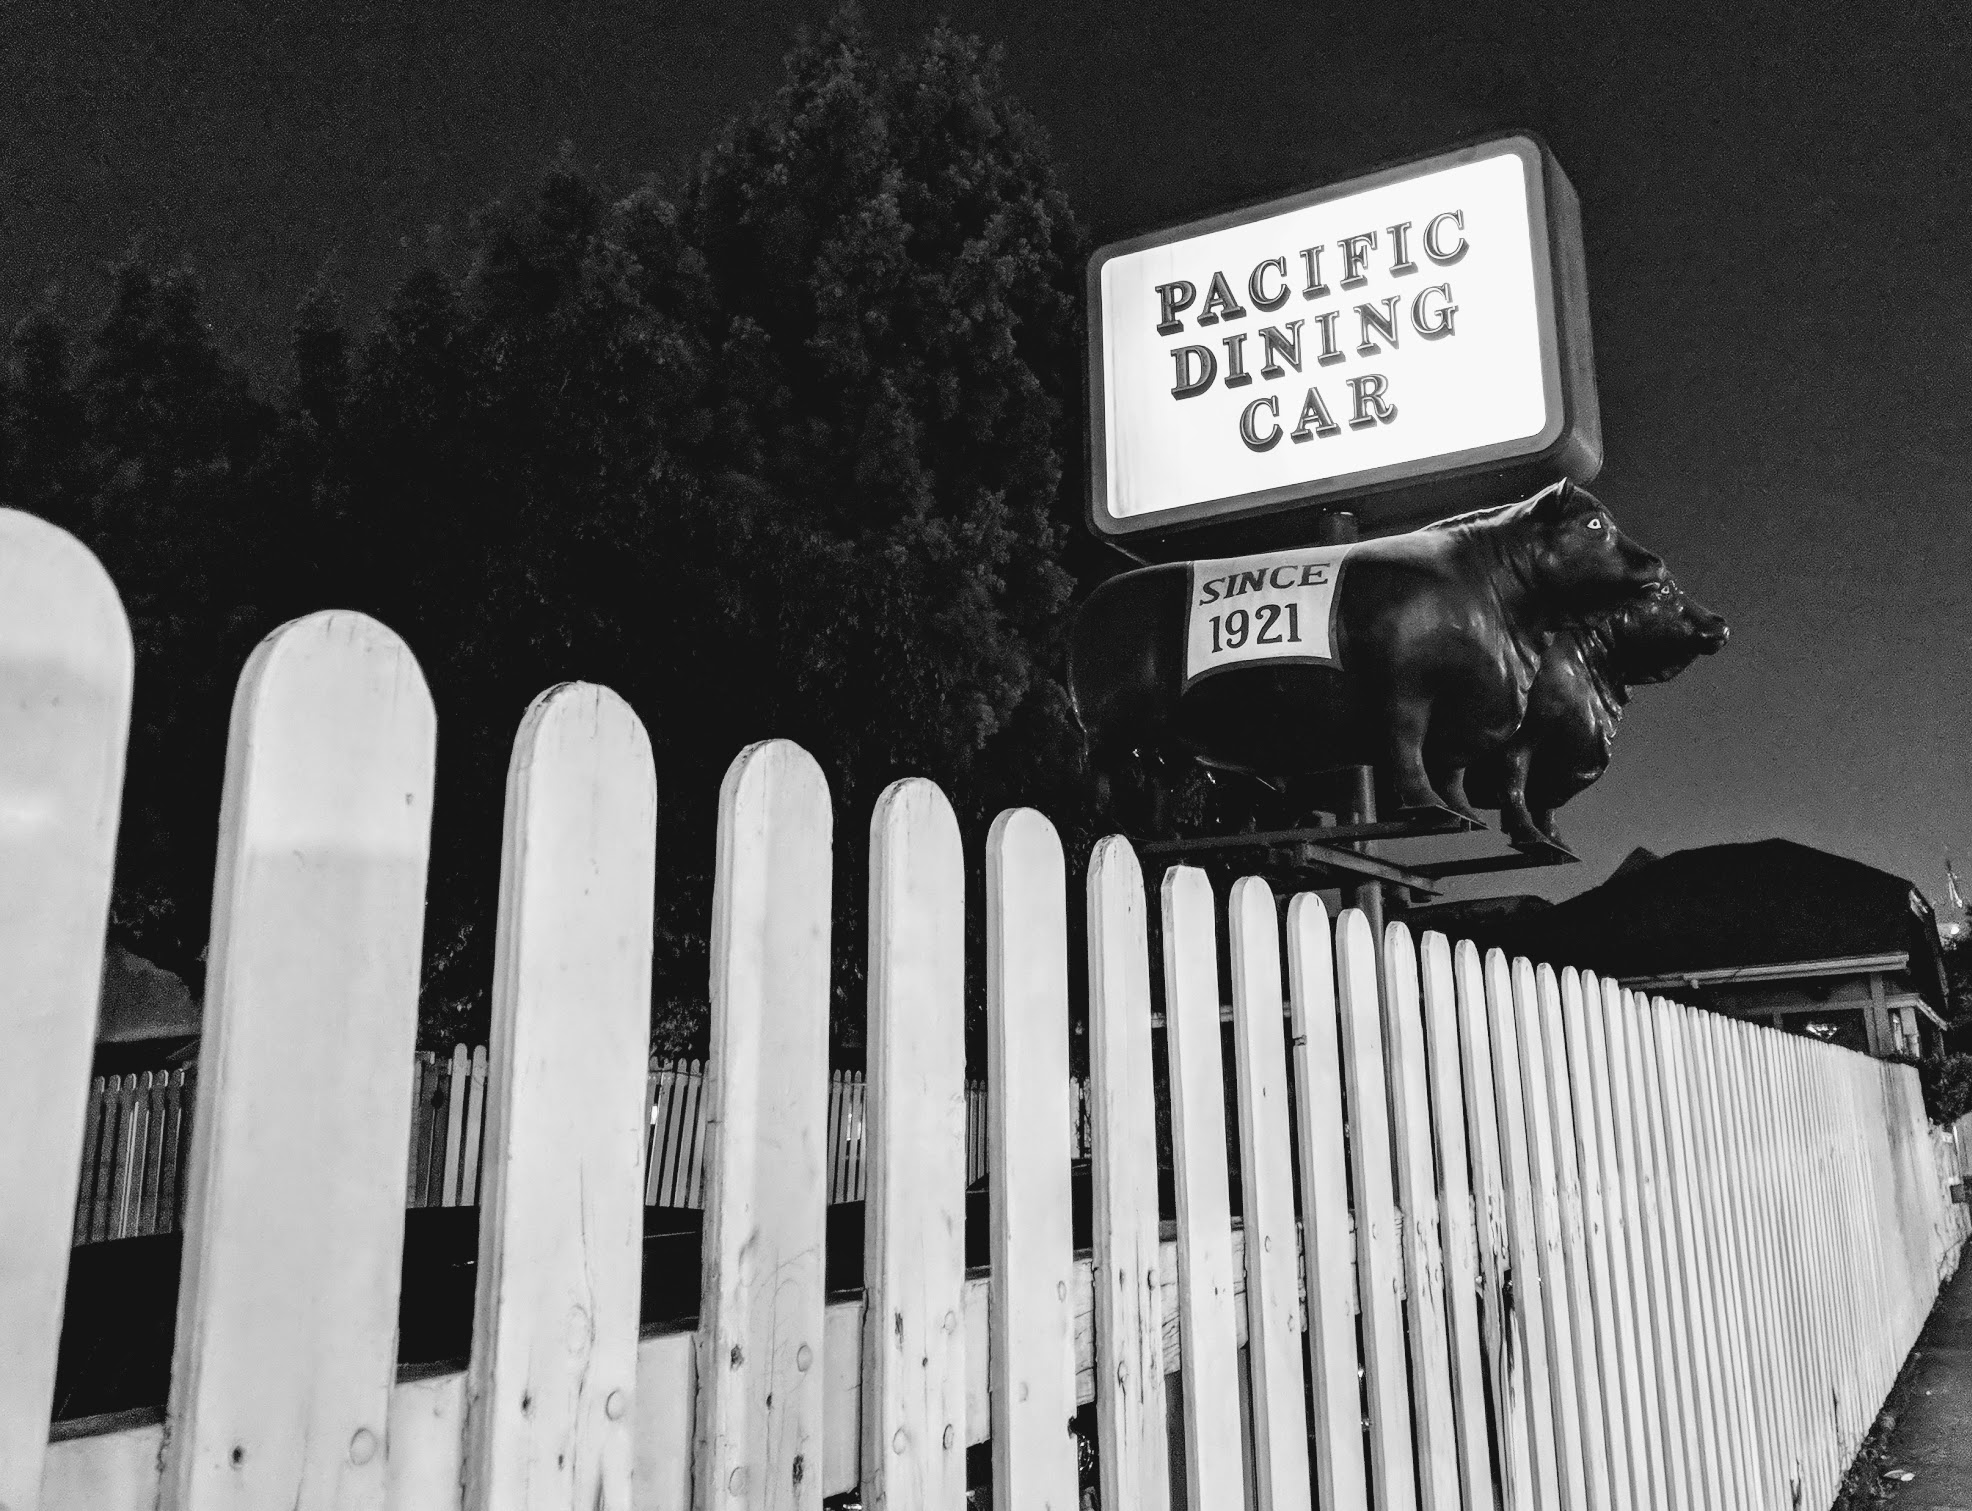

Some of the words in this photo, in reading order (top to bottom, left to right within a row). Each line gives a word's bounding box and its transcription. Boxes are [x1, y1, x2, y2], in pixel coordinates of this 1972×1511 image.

[1155, 209, 1469, 336] PACIFIC
[1170, 283, 1459, 400] DINING
[1239, 373, 1398, 452] CAR
[1199, 562, 1331, 606] SINCE
[1208, 603, 1303, 653] 1921
